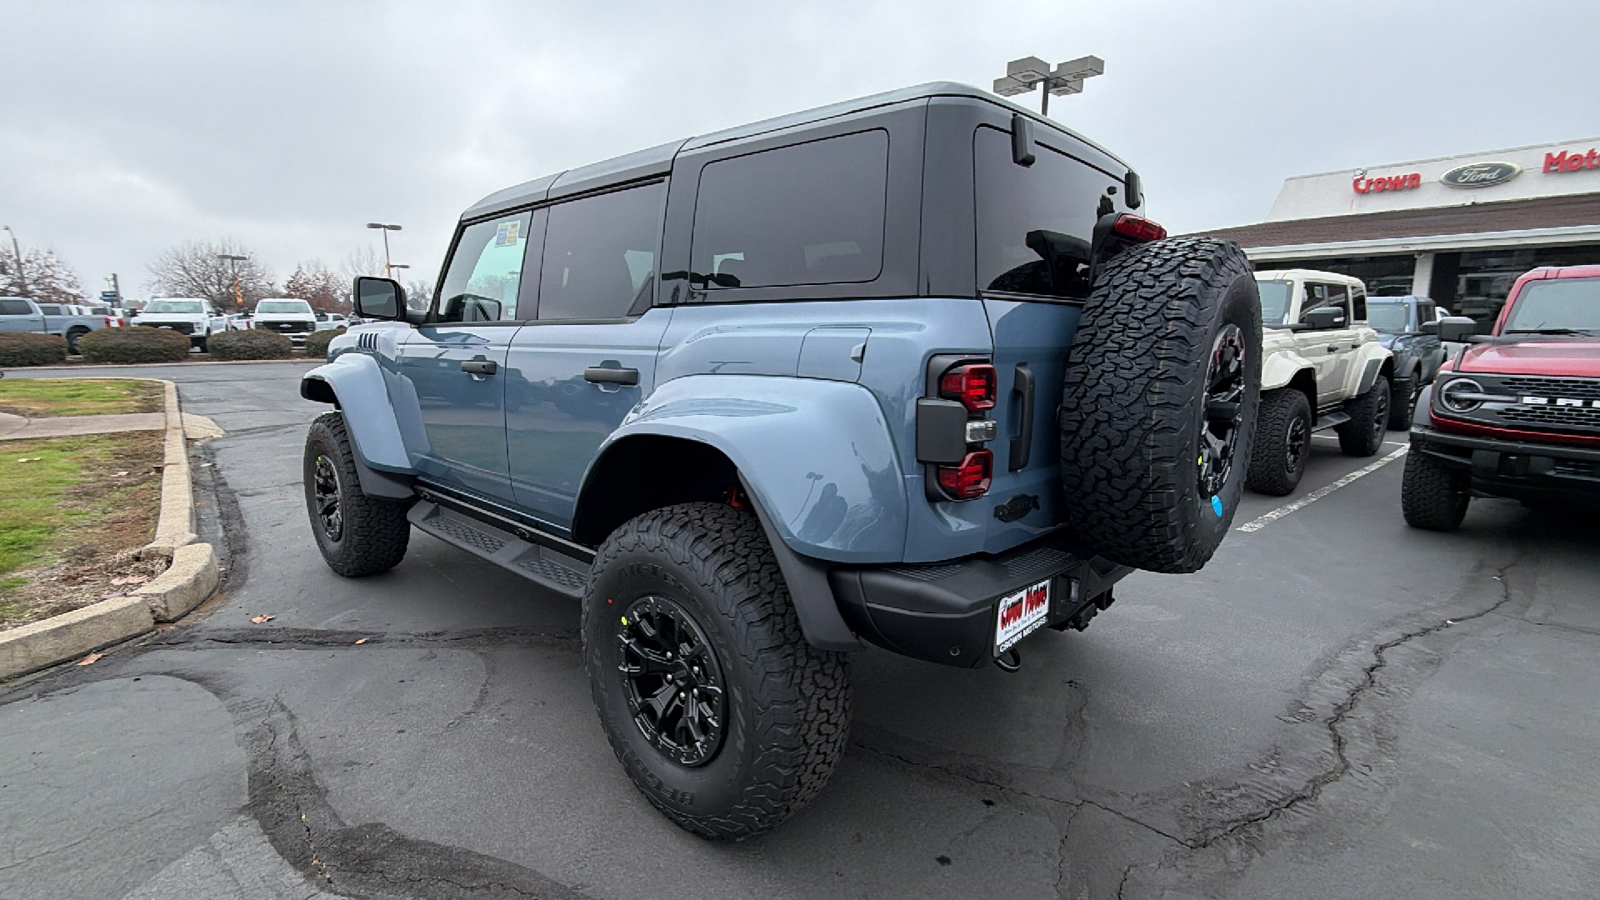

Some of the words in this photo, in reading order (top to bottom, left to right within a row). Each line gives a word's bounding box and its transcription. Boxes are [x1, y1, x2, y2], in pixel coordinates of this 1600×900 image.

[1352, 172, 1421, 194] Crown
[1457, 166, 1502, 183] Ford
[1023, 616, 1048, 638] MOTORS
